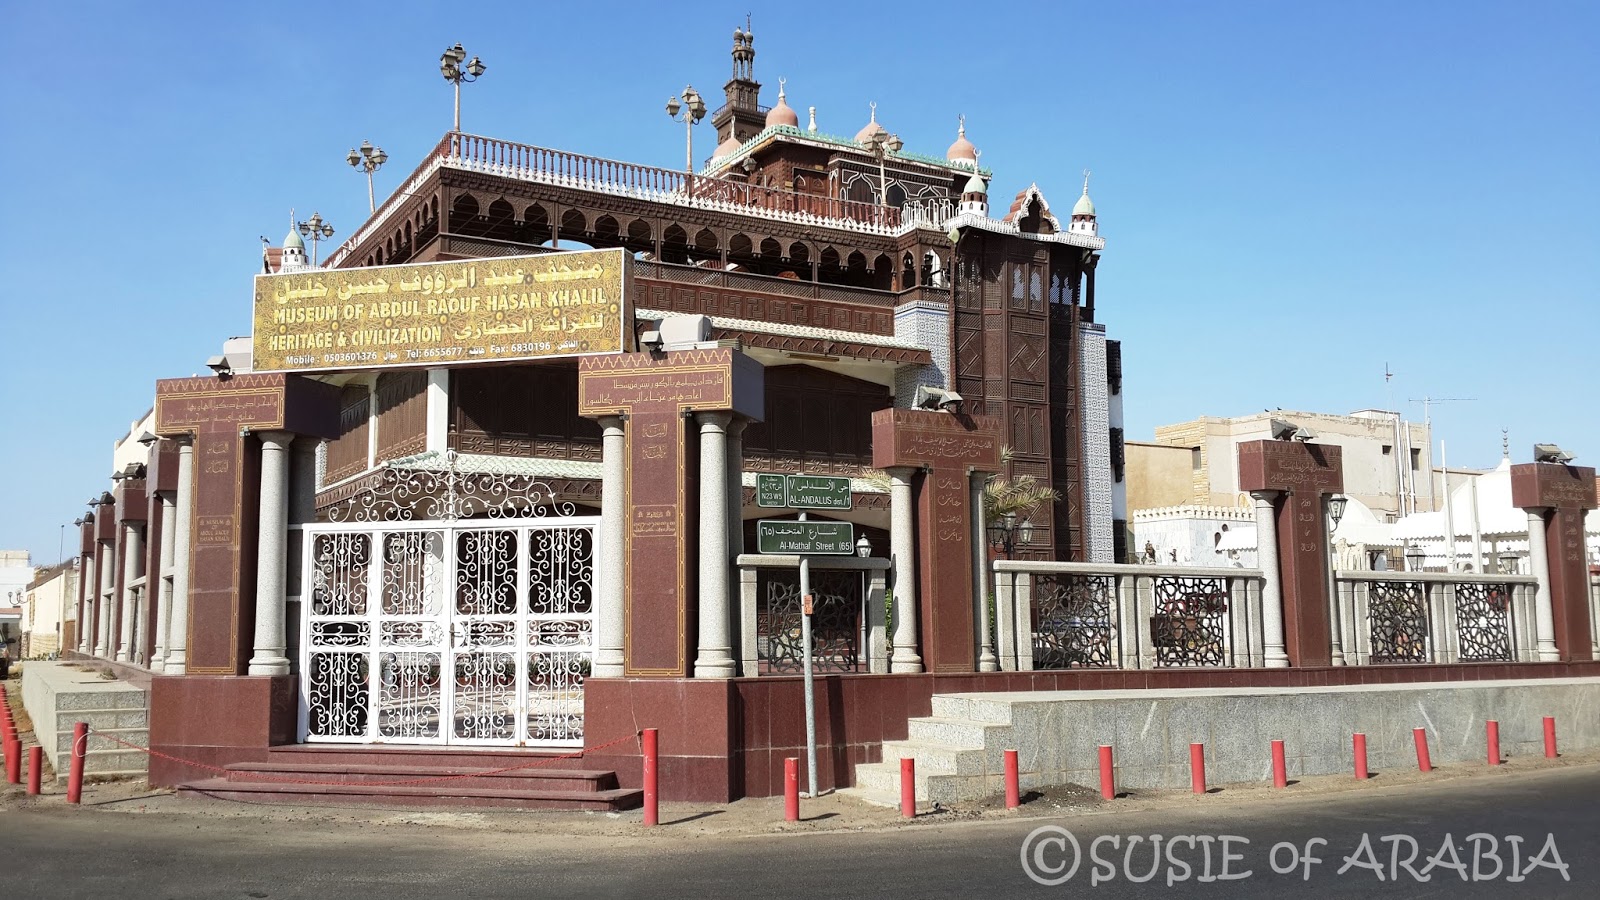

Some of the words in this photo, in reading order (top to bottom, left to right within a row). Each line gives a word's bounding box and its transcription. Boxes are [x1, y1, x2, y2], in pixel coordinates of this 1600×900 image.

[400, 266, 476, 295] الرؤوف
[484, 268, 525, 290] عبد
[534, 260, 604, 283] متحف
[275, 277, 329, 304] خليل
[338, 277, 390, 301] حسن
[275, 305, 338, 324] MUSEUM
[343, 303, 364, 320] OF
[369, 300, 422, 319] ABDUL
[427, 296, 480, 315] RAOUF
[486, 292, 542, 312] HASAN
[547, 287, 607, 308] KHALIL
[541, 312, 605, 334] للتراث
[269, 332, 333, 351] HERITAGE
[337, 331, 347, 348] &
[351, 326, 442, 346] CIVILIZATION
[286, 355, 315, 365] Mobile
[324, 352, 377, 363] 0503601376
[406, 349, 421, 359] Tel:
[423, 347, 462, 357] 6655677
[490, 343, 508, 354] Fax:
[511, 342, 550, 353] 6830196
[789, 495, 832, 505] AL-ANDALUS
[775, 525, 805, 535] المتحف
[808, 526, 838, 540] شارع
[779, 541, 811, 551] Al-Mathaf
[815, 541, 835, 551] Street
[838, 542, 852, 551] (65)
